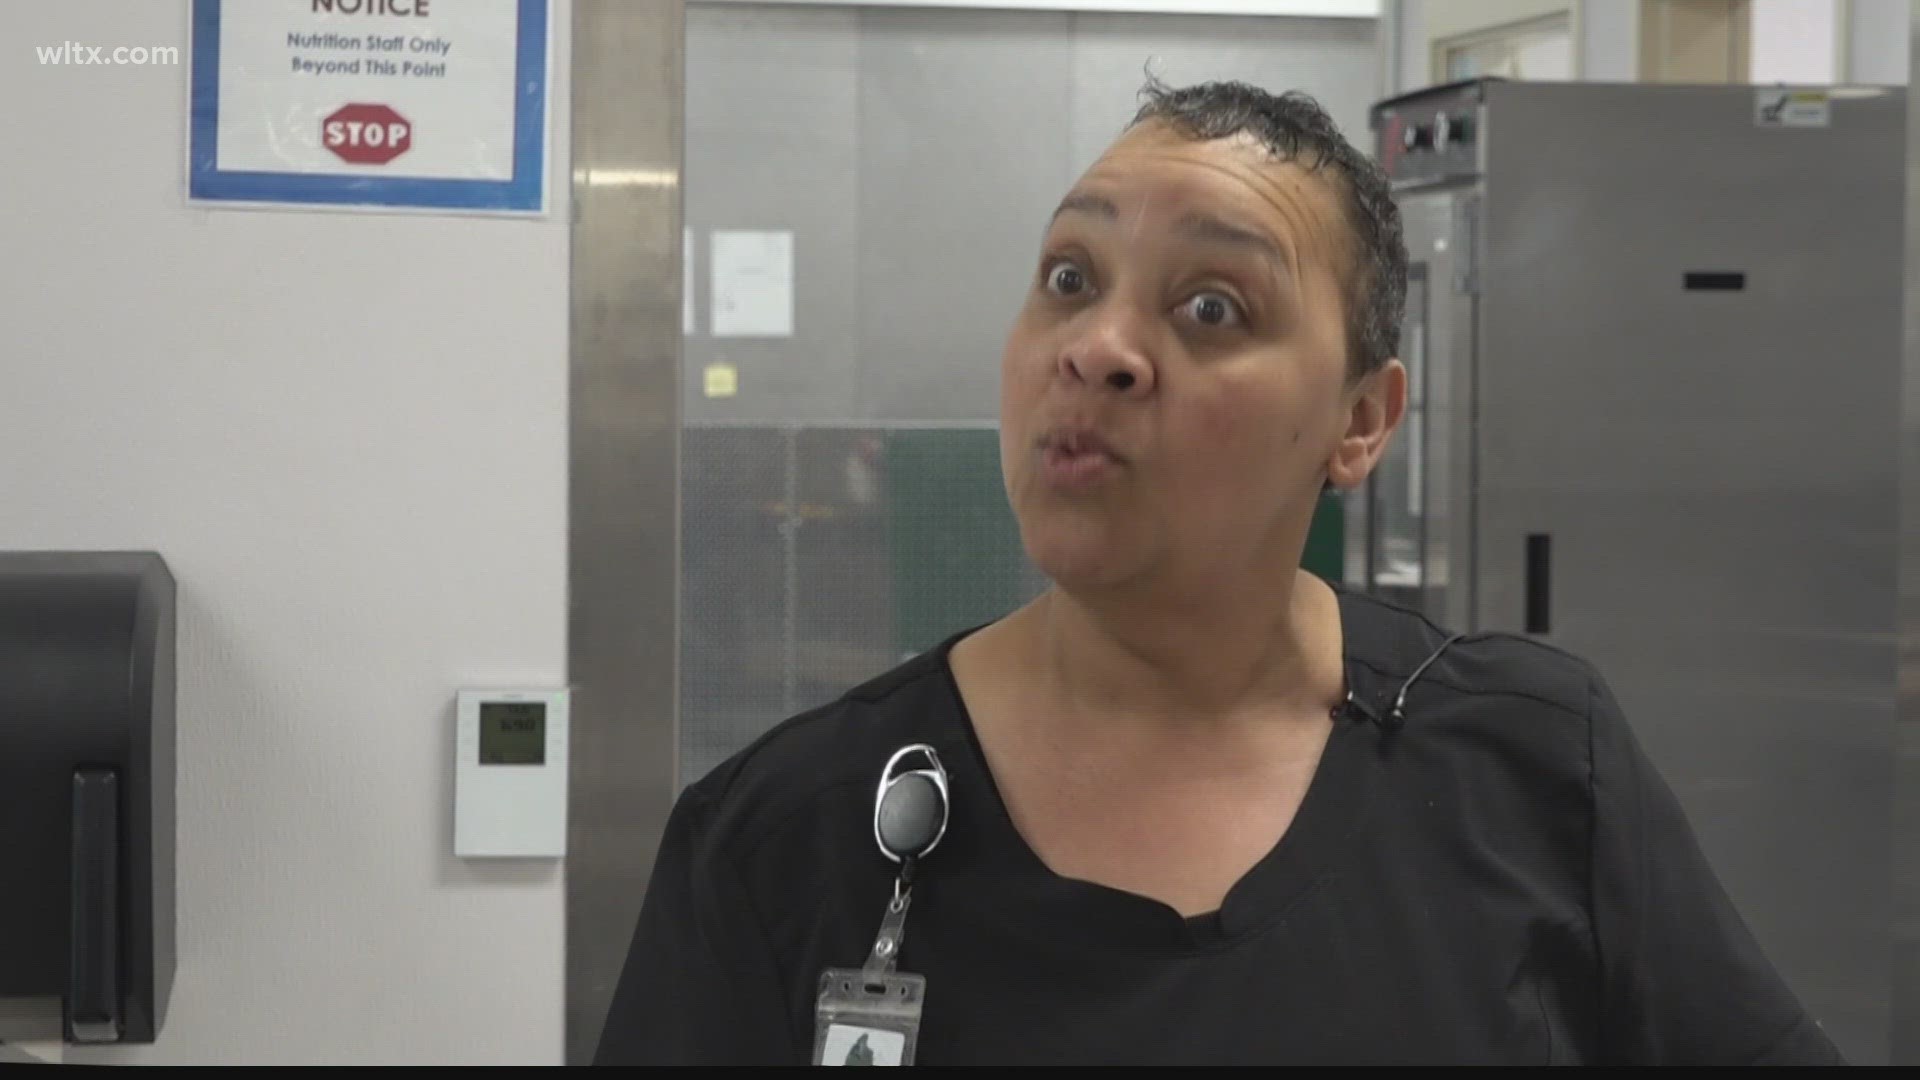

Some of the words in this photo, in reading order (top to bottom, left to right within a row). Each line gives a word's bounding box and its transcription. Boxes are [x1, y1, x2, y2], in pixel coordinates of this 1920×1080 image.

[287, 32, 361, 50] Nutrition
[366, 35, 404, 52] Staff
[409, 37, 451, 56] Only
[292, 56, 360, 76] Beyond
[365, 59, 397, 76] This
[402, 61, 446, 77] Point
[326, 121, 408, 148] STOP
